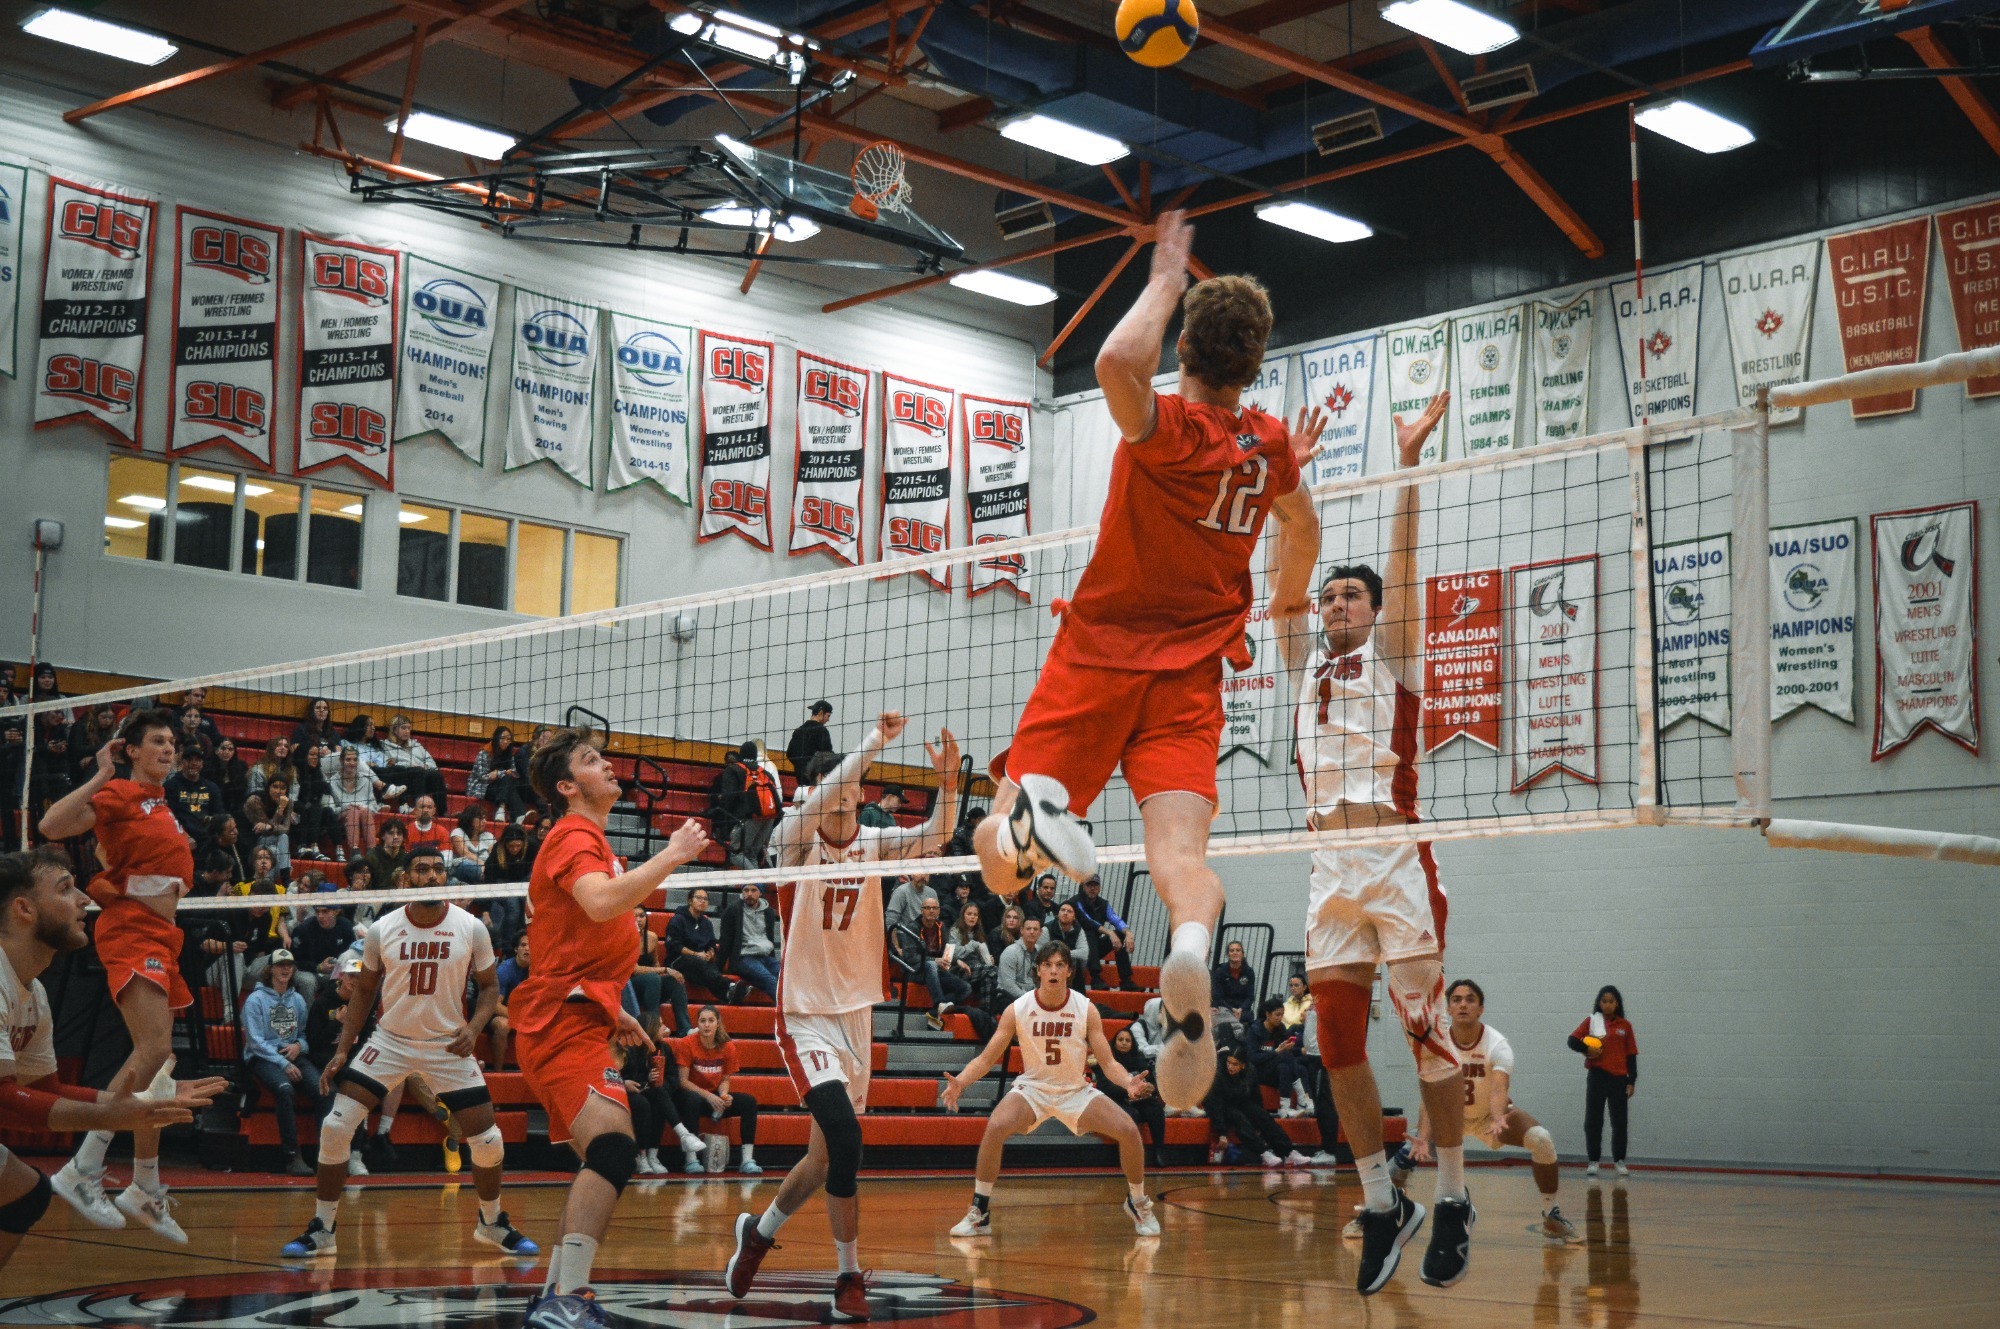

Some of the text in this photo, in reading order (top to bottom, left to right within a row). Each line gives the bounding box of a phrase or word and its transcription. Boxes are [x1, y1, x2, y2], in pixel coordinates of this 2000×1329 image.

[60, 200, 142, 250] CIS
[191, 227, 270, 275] CIS
[1840, 243, 1915, 274] C.I.A.U.
[61, 268, 94, 280] WOMEN
[313, 253, 388, 298] CIS
[1728, 264, 1810, 295] O.U.A.A.
[71, 281, 124, 291] WRESTLING
[1841, 279, 1916, 307] U.S.I.C.
[191, 295, 224, 306] WOMEN
[230, 293, 265, 305] FEMMES
[64, 304, 126, 316] 2012-13
[204, 306, 251, 318] WRESTLING
[412, 289, 488, 329] OUA
[49, 318, 137, 334] CHAMPIONS
[320, 318, 339, 329] MEN
[343, 316, 378, 327] HOMMES
[1846, 315, 1914, 338] BASKETBALL
[196, 330, 258, 342] 2013-14
[327, 328, 371, 340] WRESTLING
[521, 321, 589, 357] OUA
[185, 342, 269, 361] CHAMPIONS
[319, 351, 378, 364] 2013-14
[617, 341, 684, 375] OUA
[1849, 346, 1913, 368] (MEN/HOMMES)
[711, 347, 764, 385] CIS
[1308, 351, 1368, 380] O.U.A.A.
[1741, 352, 1801, 375] WRESTLING
[46, 354, 134, 403] SIC
[309, 364, 385, 382] CHAMPIONS
[428, 374, 458, 389] Men's
[1542, 371, 1584, 387] CURLING
[419, 384, 464, 402] Baseball
[805, 369, 860, 410] CIS
[1470, 384, 1510, 400] FENCING
[185, 381, 265, 427] SIC
[538, 404, 563, 418] Men's
[614, 398, 686, 424] CHAMPIONS
[893, 391, 946, 430] CIS
[1635, 395, 1691, 418] CAMPIONS
[310, 402, 385, 446] SIC
[425, 409, 454, 424] 2014
[533, 415, 567, 431] Rowing
[1469, 409, 1511, 426] CHAMPS
[629, 423, 670, 438] Women's
[808, 426, 822, 435] MEN
[825, 425, 852, 434] HOMMES
[973, 411, 1023, 445] CIS
[1321, 424, 1357, 441] ROWING
[535, 438, 562, 451] 2014
[629, 435, 673, 450] Wrestling
[812, 435, 846, 445] WRESTLING
[808, 454, 850, 464] 2014-15
[893, 447, 914, 456] WOMEN
[918, 445, 941, 454] FEMMES
[1315, 443, 1363, 461] CHAMPIONS
[629, 457, 671, 472] 2014-15
[903, 455, 933, 465] WRESTLING
[980, 466, 993, 475] MEN
[996, 460, 1017, 472] HOMMES
[985, 472, 1013, 483] WRESTLING
[1321, 464, 1358, 478] 1972-73
[895, 474, 937, 486] 2015-16
[710, 479, 765, 515] SIC
[889, 485, 943, 500] CHAMPIONS
[981, 489, 1021, 503] 2015-16
[1195, 453, 1268, 534] 12
[802, 496, 854, 536] SIC
[974, 497, 1027, 519] CHAMPIONS
[889, 517, 943, 554] SIC
[1655, 550, 1723, 574] UA/SUO
[1437, 575, 1489, 592] CURC
[1907, 583, 1943, 600] 2001
[1428, 627, 1499, 645] CANADIAN
[1540, 622, 1570, 639] 2000
[1770, 616, 1853, 640] HAMPIONS
[1895, 624, 1957, 643] WRESTLING
[1426, 643, 1499, 661] UNIVERSITY
[1779, 643, 1835, 657] Women's
[1911, 650, 1940, 664] LUTTE
[1435, 660, 1493, 676] ROWING
[1669, 657, 1703, 669] Men's
[1777, 659, 1838, 673] Wrestling
[1219, 676, 1275, 693] AMPIONS
[1527, 673, 1586, 690] WRESTLING
[1659, 670, 1716, 686] Wrestling
[1898, 672, 1954, 687] MASCULIN
[1776, 681, 1839, 695] 2000-2001
[1227, 700, 1252, 710] Men's
[1424, 693, 1502, 710] CHAMPIONS
[1538, 695, 1571, 708] LUTTE
[1659, 691, 1718, 707] 2000-2001
[1224, 712, 1256, 723] Rowing
[1443, 711, 1481, 725] 1999
[1529, 714, 1582, 729] MASCULIN
[1229, 725, 1250, 735] 1999
[1527, 744, 1586, 760] CHAMPIONS
[822, 888, 860, 931] 17
[400, 941, 450, 960] LIONS
[408, 962, 438, 996] 10
[1032, 1021, 1073, 1037] LIONS
[359, 1045, 380, 1066] 10
[1045, 1039, 1062, 1065] 5
[810, 1050, 829, 1072] 17
[1462, 1063, 1486, 1078] ONS
